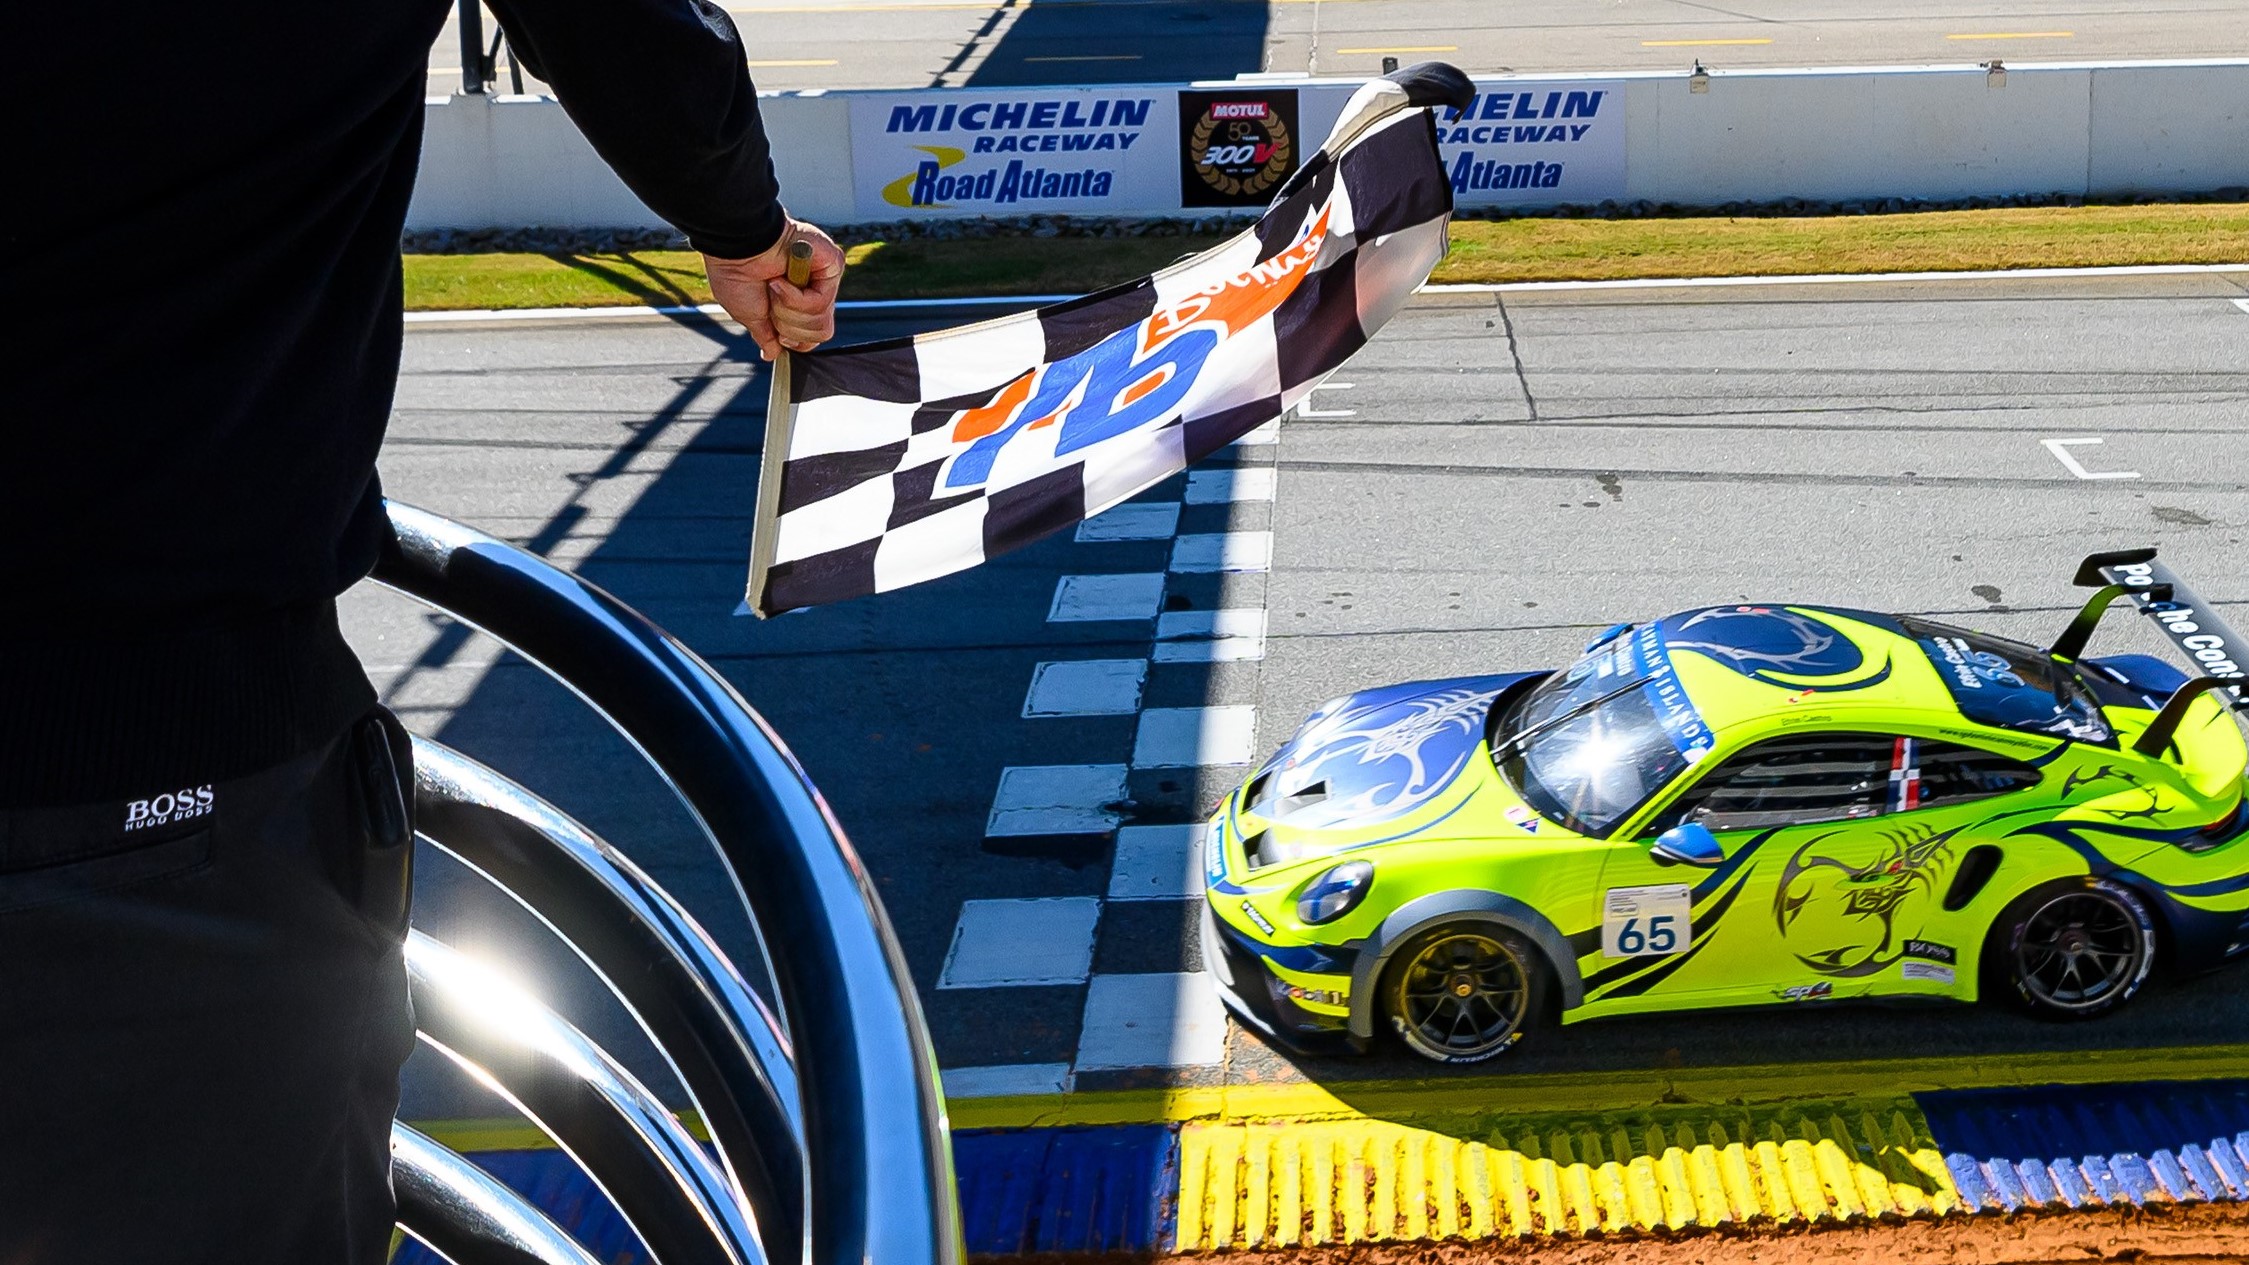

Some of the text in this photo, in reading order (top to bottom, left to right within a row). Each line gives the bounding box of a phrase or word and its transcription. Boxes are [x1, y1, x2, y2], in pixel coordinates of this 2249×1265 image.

[886, 99, 1151, 133] MICHELIN
[1213, 104, 1265, 117] MOTUL
[1434, 91, 1604, 119] HELIN
[973, 132, 1140, 154] RACEWAY
[1228, 122, 1251, 141] 50
[1201, 143, 1281, 165] 300V
[911, 159, 1111, 205] Road Atlanta
[1451, 151, 1564, 194] Atlanta
[126, 784, 214, 822] BOSS
[1618, 915, 1676, 954] 65
